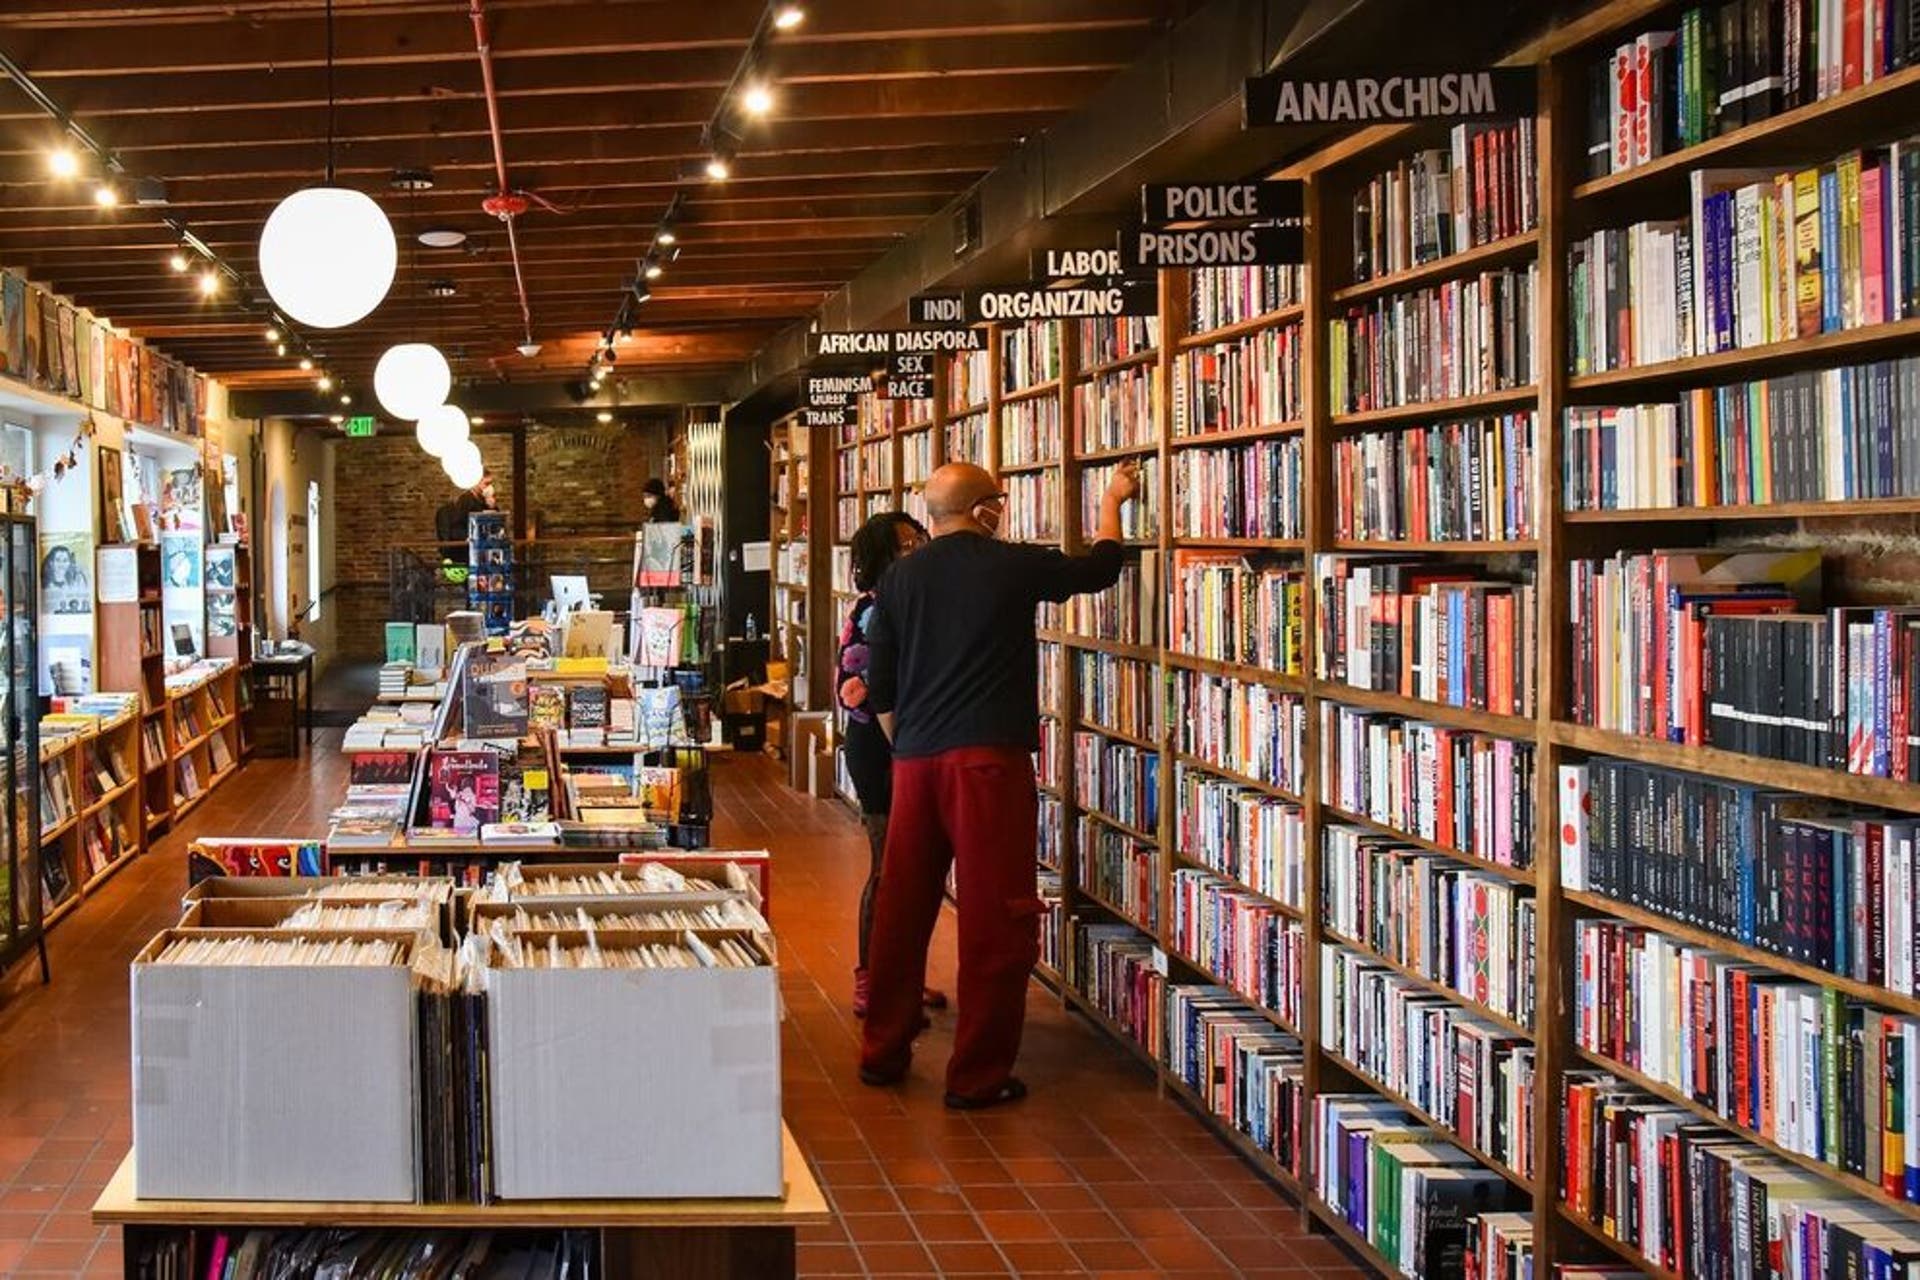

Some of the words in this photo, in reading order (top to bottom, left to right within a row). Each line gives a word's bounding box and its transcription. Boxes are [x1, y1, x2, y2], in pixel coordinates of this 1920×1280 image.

[1276, 72, 1496, 123] ANARCHISM
[1166, 185, 1258, 218] POLICE
[1138, 230, 1257, 265] PRISONS
[1048, 250, 1123, 276] LABOR
[980, 288, 1124, 319] ORGANIZING
[819, 333, 890, 354] AFRICAN
[895, 330, 980, 351] DIASPORA
[897, 356, 923, 373] SEX
[809, 376, 873, 393] FEMINISM
[888, 381, 925, 397] RACE
[806, 410, 845, 425] TRANS
[1736, 1181, 1749, 1221] ANGELA
[1751, 1186, 1763, 1270] IMPERIALISM
